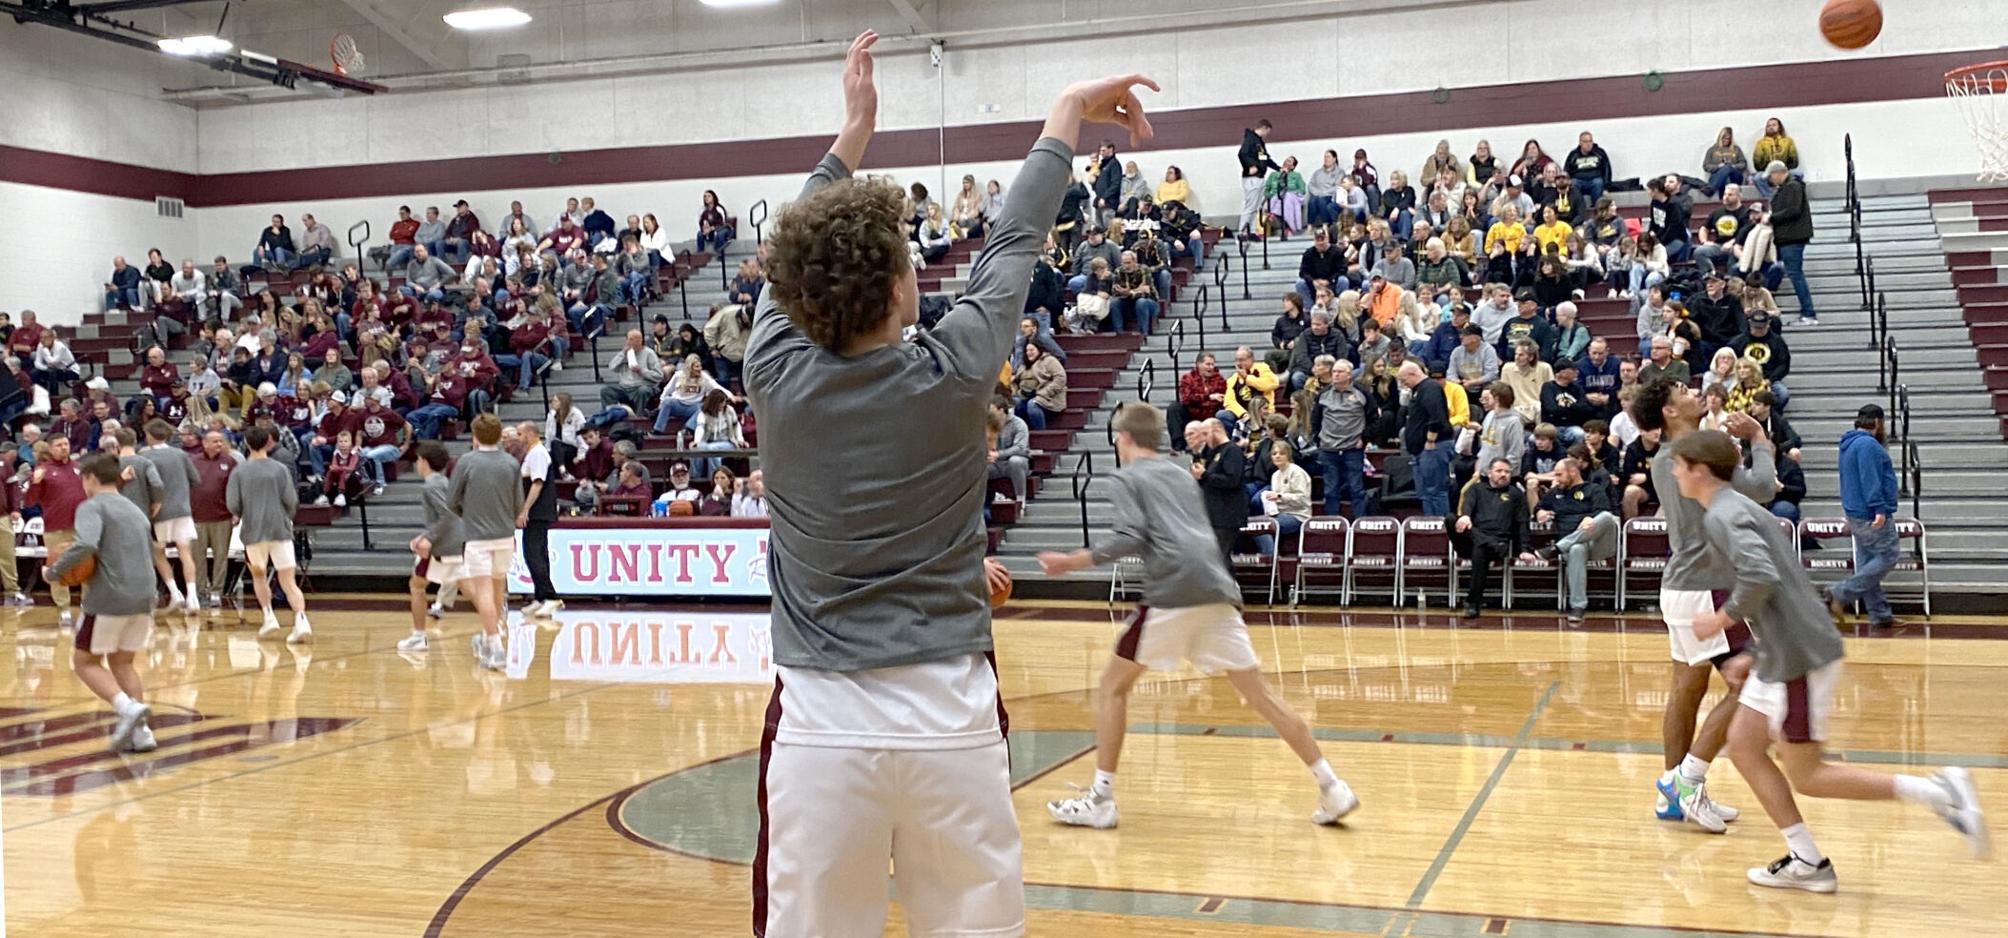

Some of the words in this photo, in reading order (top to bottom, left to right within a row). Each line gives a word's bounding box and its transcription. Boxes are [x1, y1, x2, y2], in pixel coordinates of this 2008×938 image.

[1309, 520, 1342, 530] UNITY
[1359, 520, 1392, 530] UNITY
[1409, 520, 1444, 530] UNITY
[1806, 522, 1846, 533] UNITY
[1894, 522, 1916, 533] ITY
[570, 544, 736, 583] UNITY
[1810, 559, 1848, 569] ROCKETS
